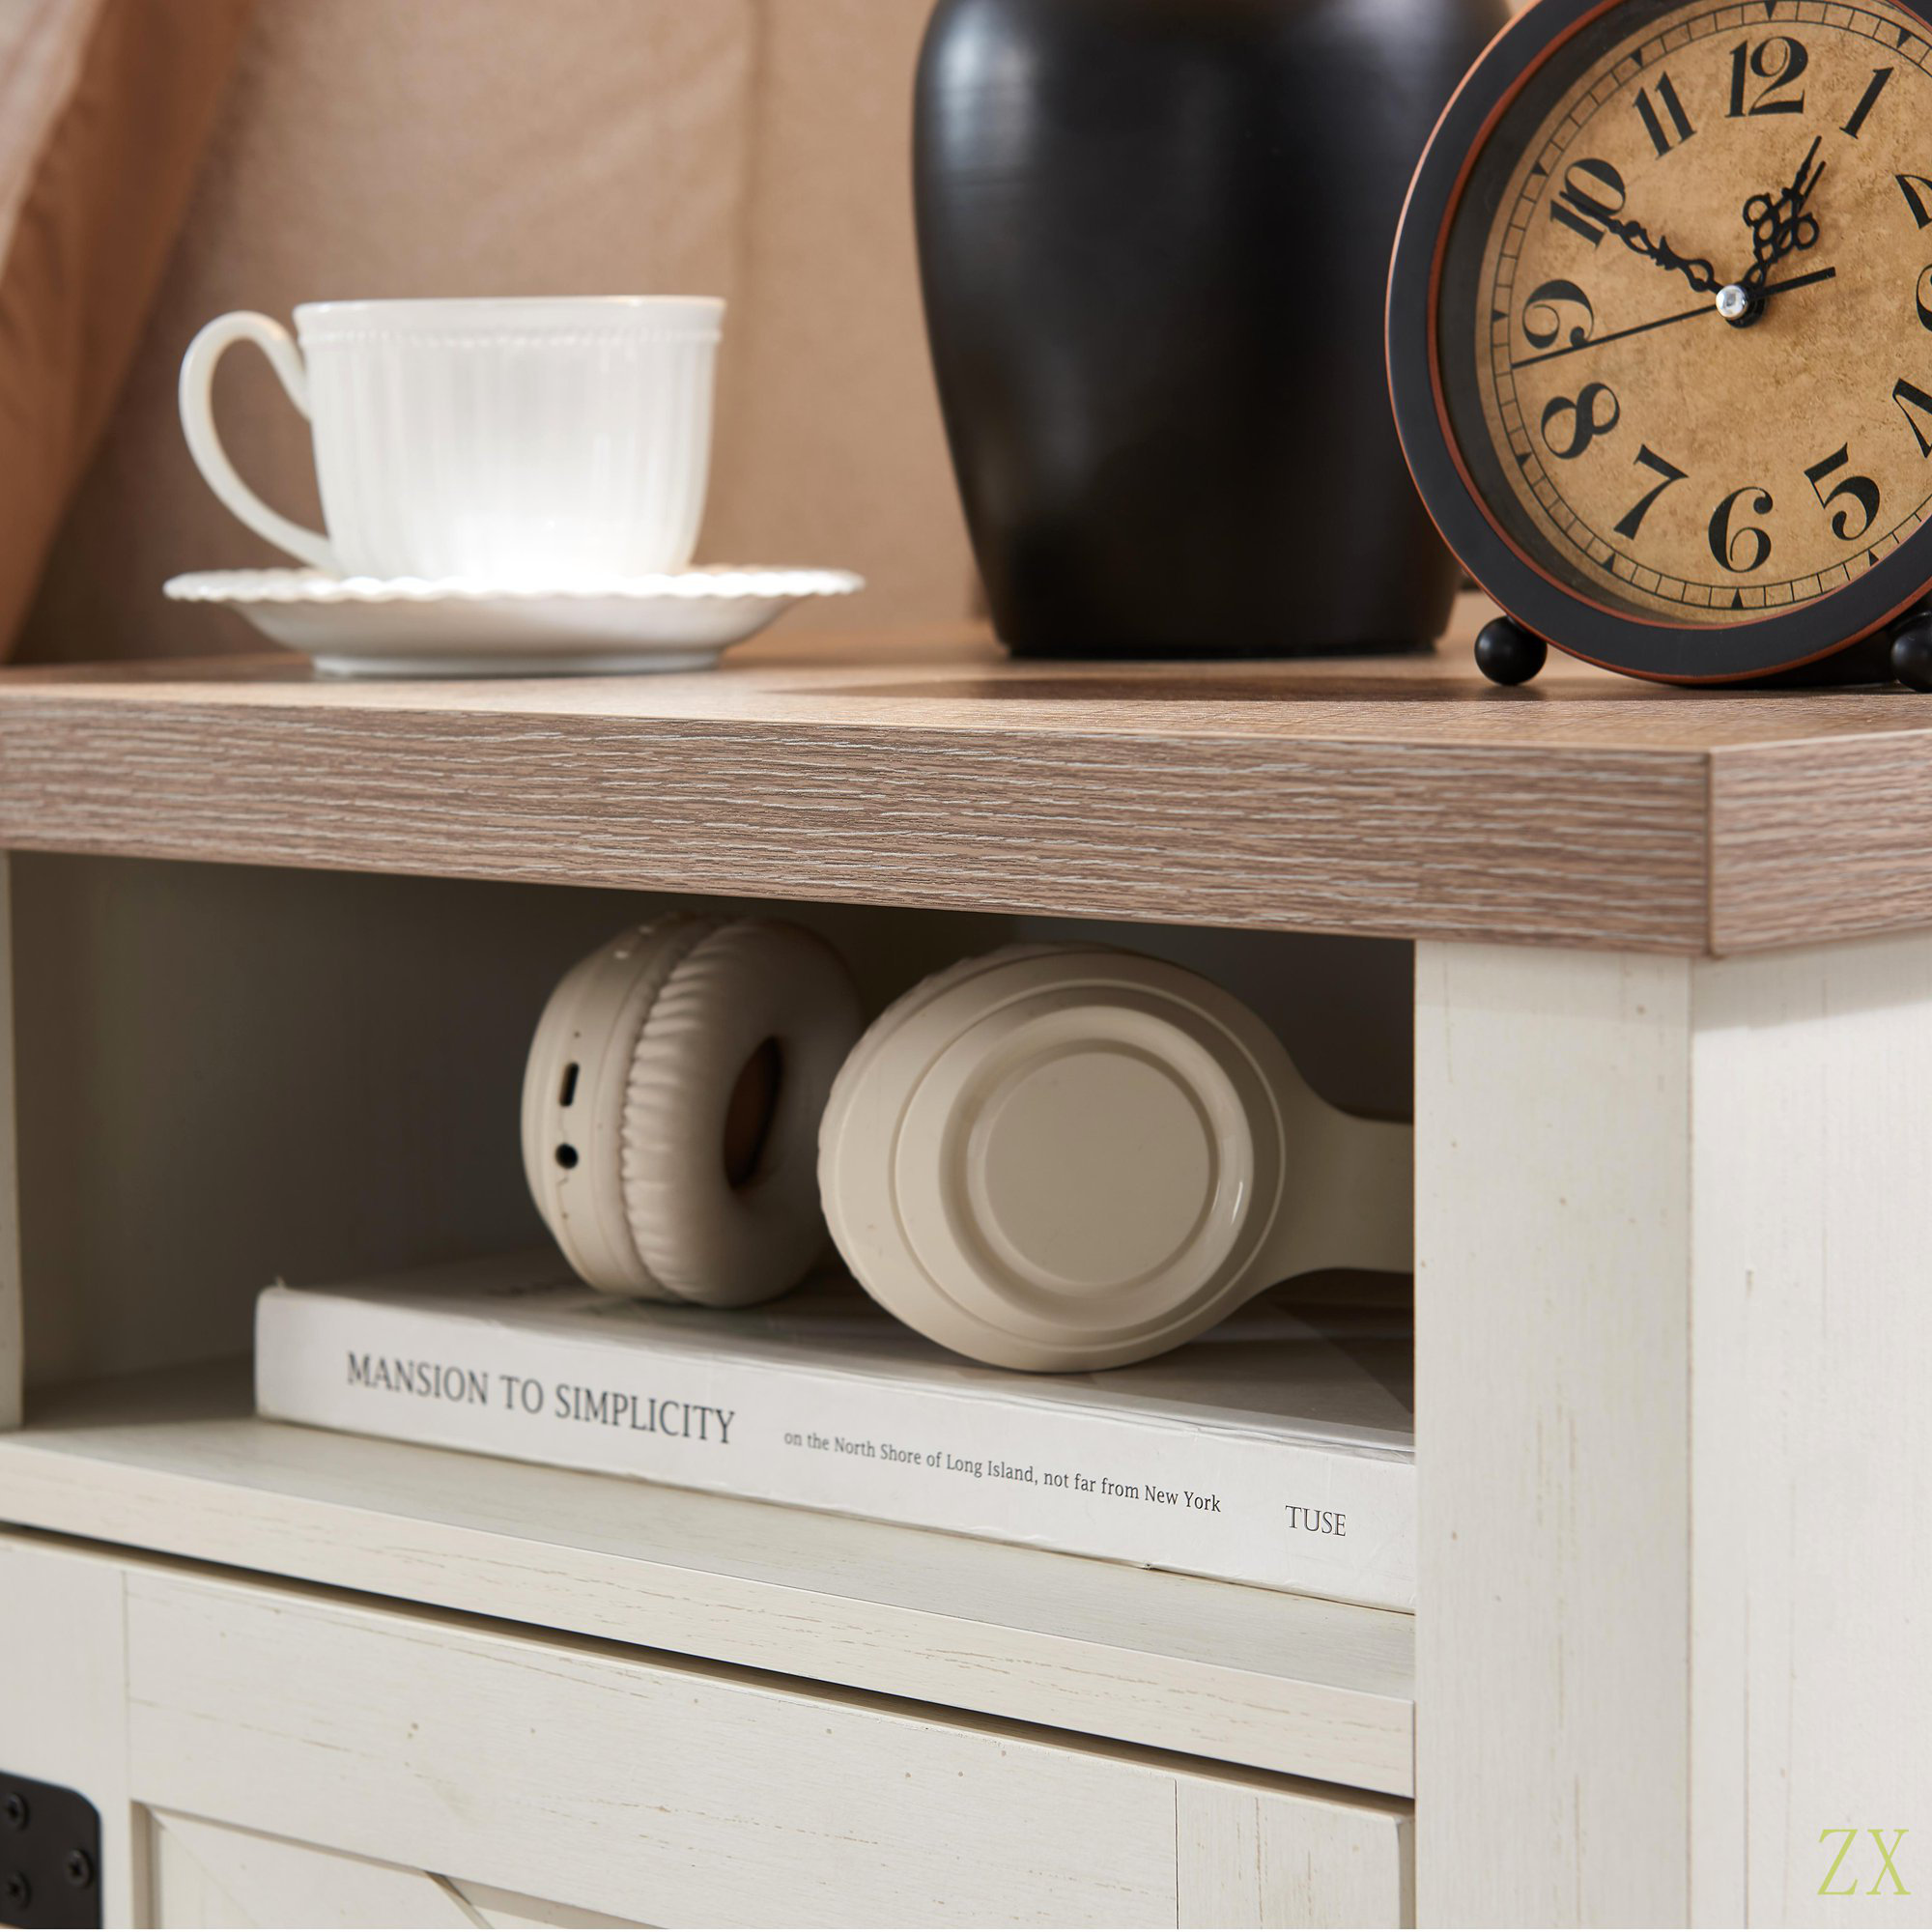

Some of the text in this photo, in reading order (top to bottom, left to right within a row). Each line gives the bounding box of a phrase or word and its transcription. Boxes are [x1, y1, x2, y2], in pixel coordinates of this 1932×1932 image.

[1633, 71, 1697, 159] 11
[1725, 36, 1808, 118] 12
[1838, 67, 1894, 140] 1
[1548, 157, 1627, 248] 10
[1521, 279, 1595, 349] 9
[1541, 383, 1621, 460] 8
[1612, 443, 1689, 540] 7
[1708, 486, 1774, 573] 6
[1804, 441, 1881, 541] 5
[347, 1351, 736, 1444] MANSION TO SIMPLICITY
[783, 1432, 1222, 1513] on the North Shore of Long Island, not far from New York
[1284, 1504, 1348, 1537] TUSE
